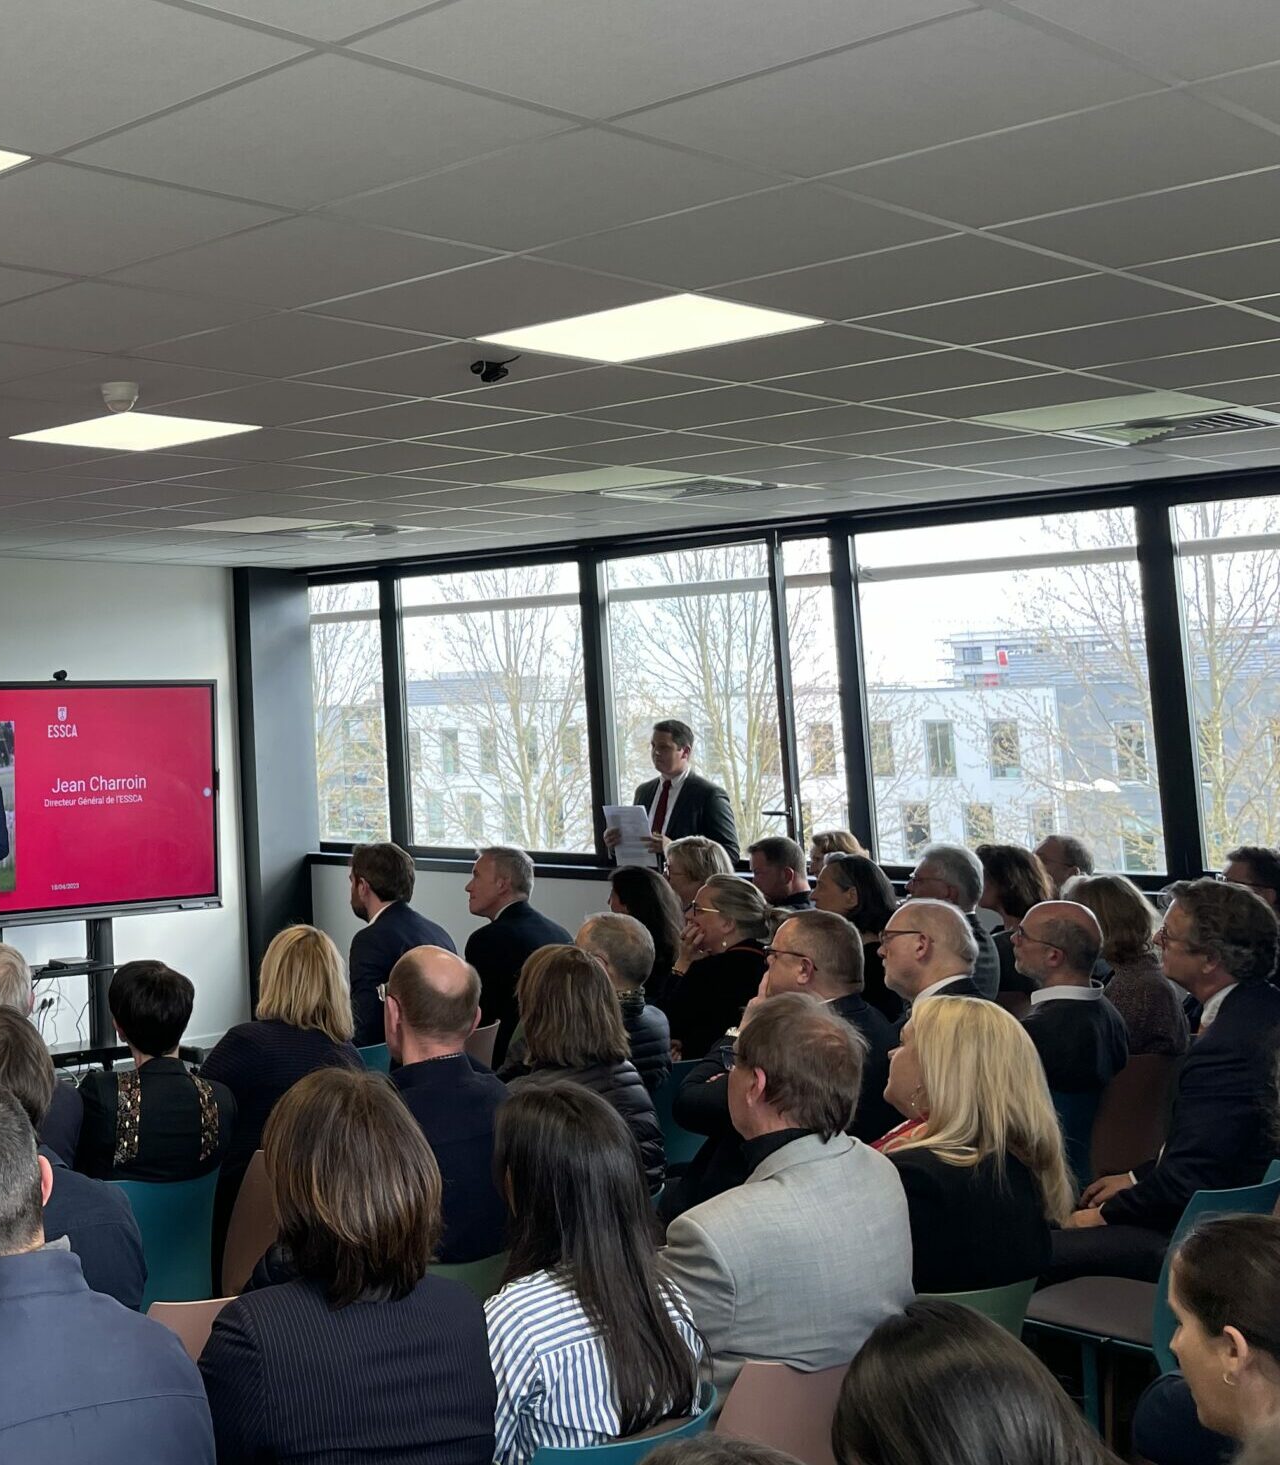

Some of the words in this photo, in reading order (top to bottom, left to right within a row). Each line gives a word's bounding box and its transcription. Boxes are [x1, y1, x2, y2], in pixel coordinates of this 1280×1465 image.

[48, 724, 77, 738] ESSCA
[52, 778, 86, 793] Jean
[89, 774, 147, 792] Charroin
[44, 798, 76, 808] Directeur
[77, 796, 105, 806] Général
[106, 795, 115, 804] de
[116, 794, 143, 804] l'ESSCA
